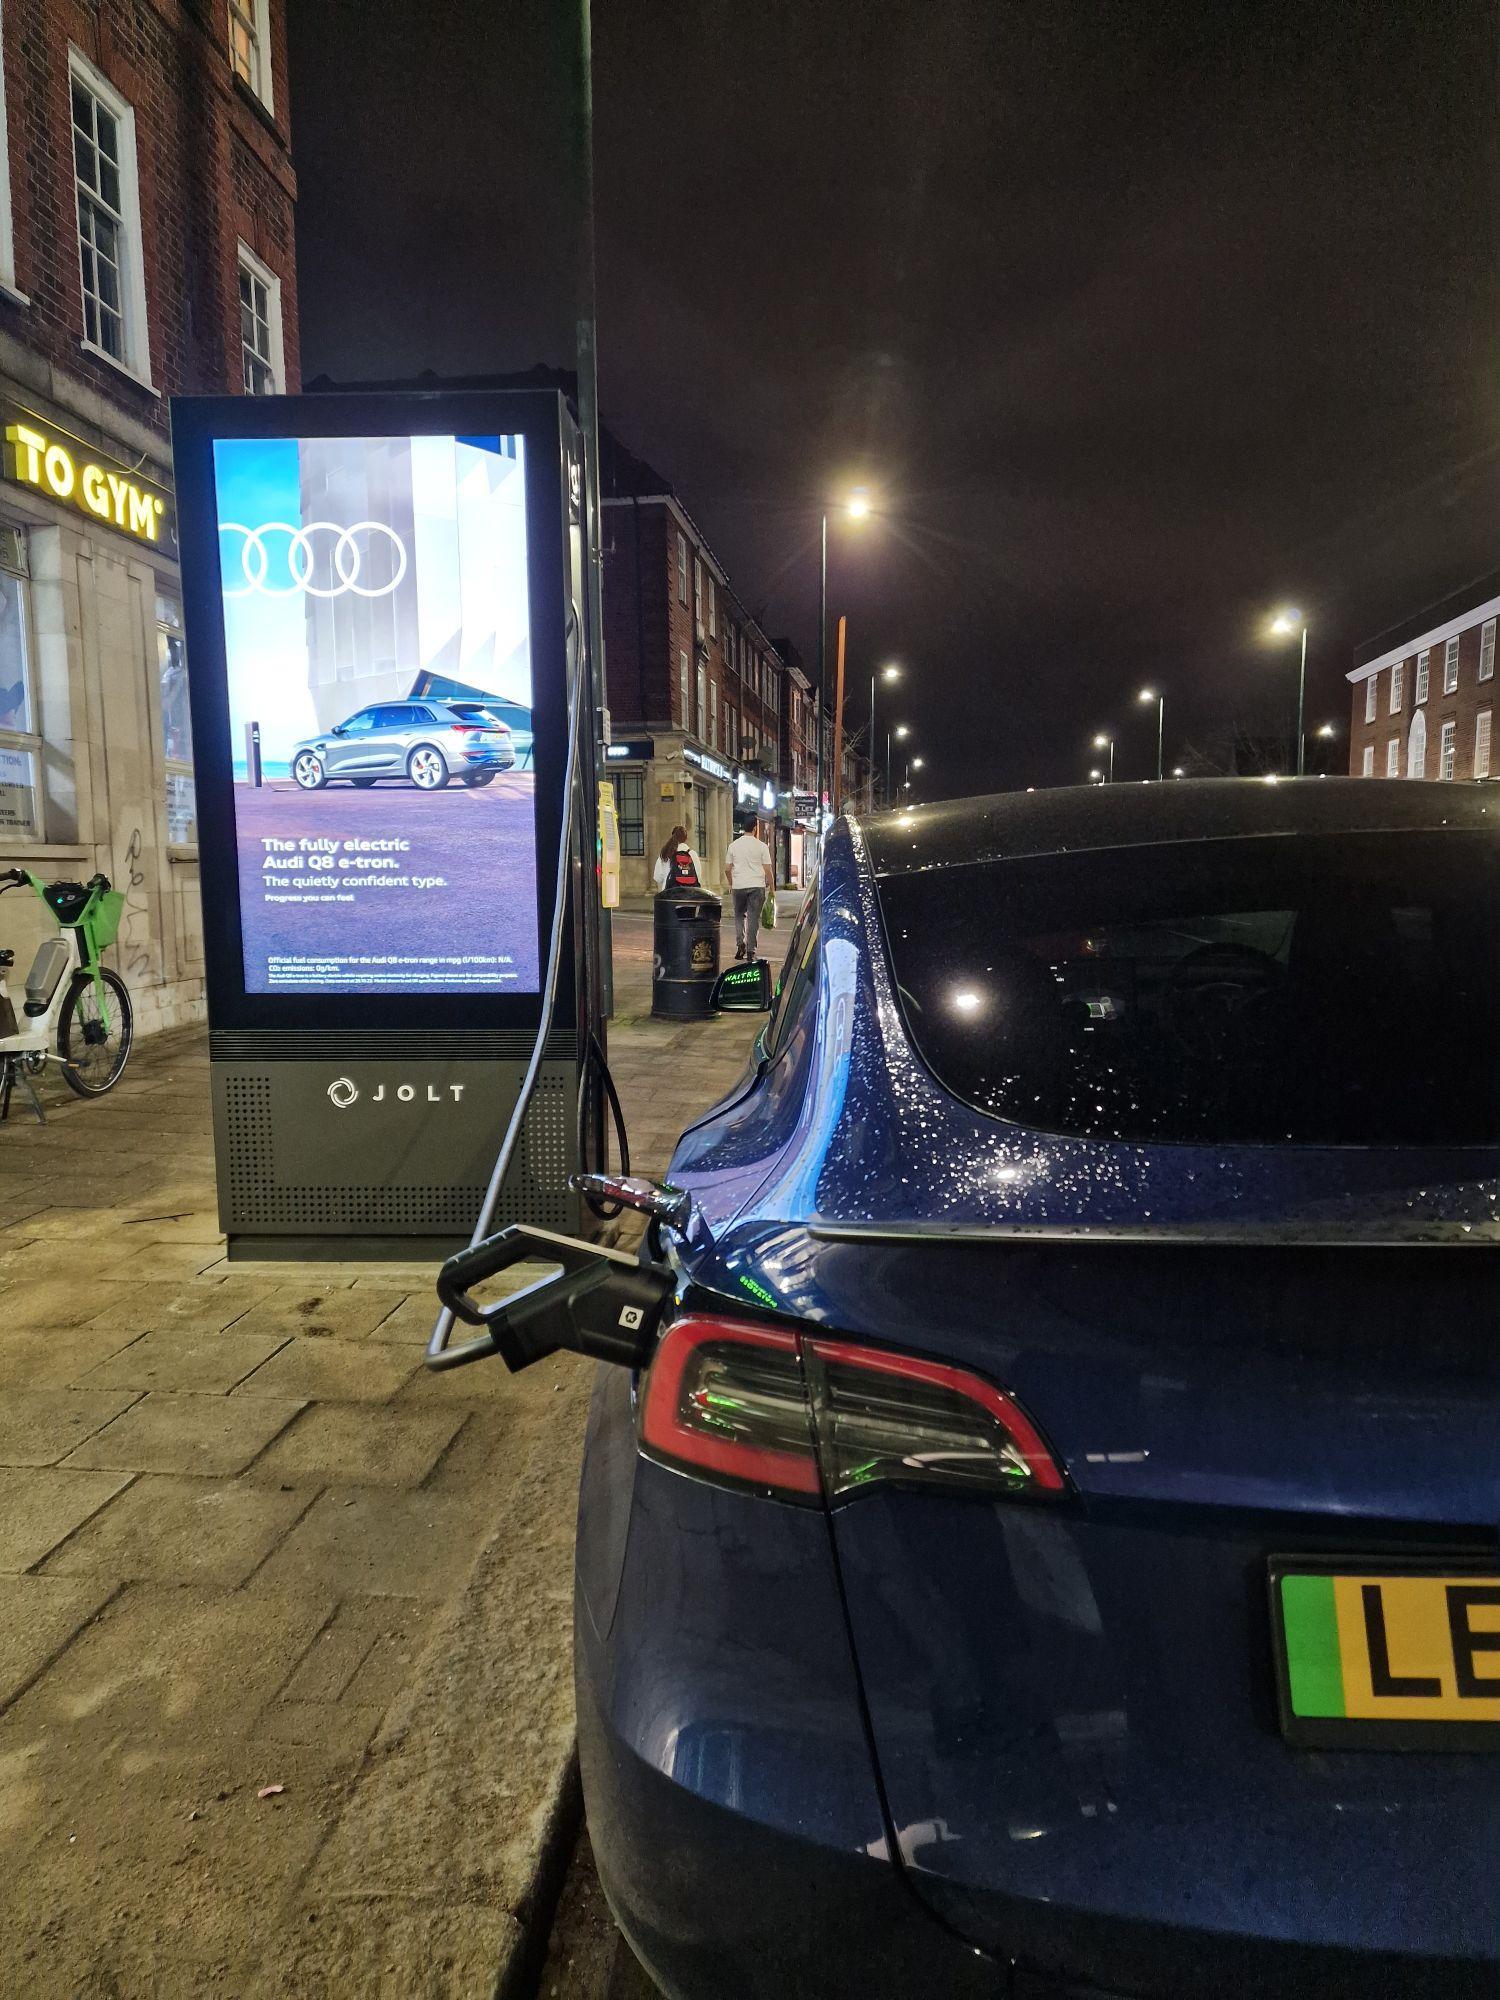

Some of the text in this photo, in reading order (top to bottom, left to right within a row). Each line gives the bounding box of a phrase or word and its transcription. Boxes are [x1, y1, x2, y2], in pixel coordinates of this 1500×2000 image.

[8, 424, 74, 498] TO
[261, 838, 410, 854] The fully electric
[262, 855, 400, 871] Audi Q8 e-tron.
[262, 875, 448, 889] The quietly confident type.
[264, 894, 302, 903] Progress
[302, 895, 319, 903] you
[293, 956, 306, 964] fuel
[306, 956, 348, 965] consumption
[349, 956, 360, 964] for
[360, 956, 371, 964] the
[372, 956, 387, 964] Audi
[372, 1085, 464, 1102] JOLT
[1361, 1584, 1500, 1698] LE
